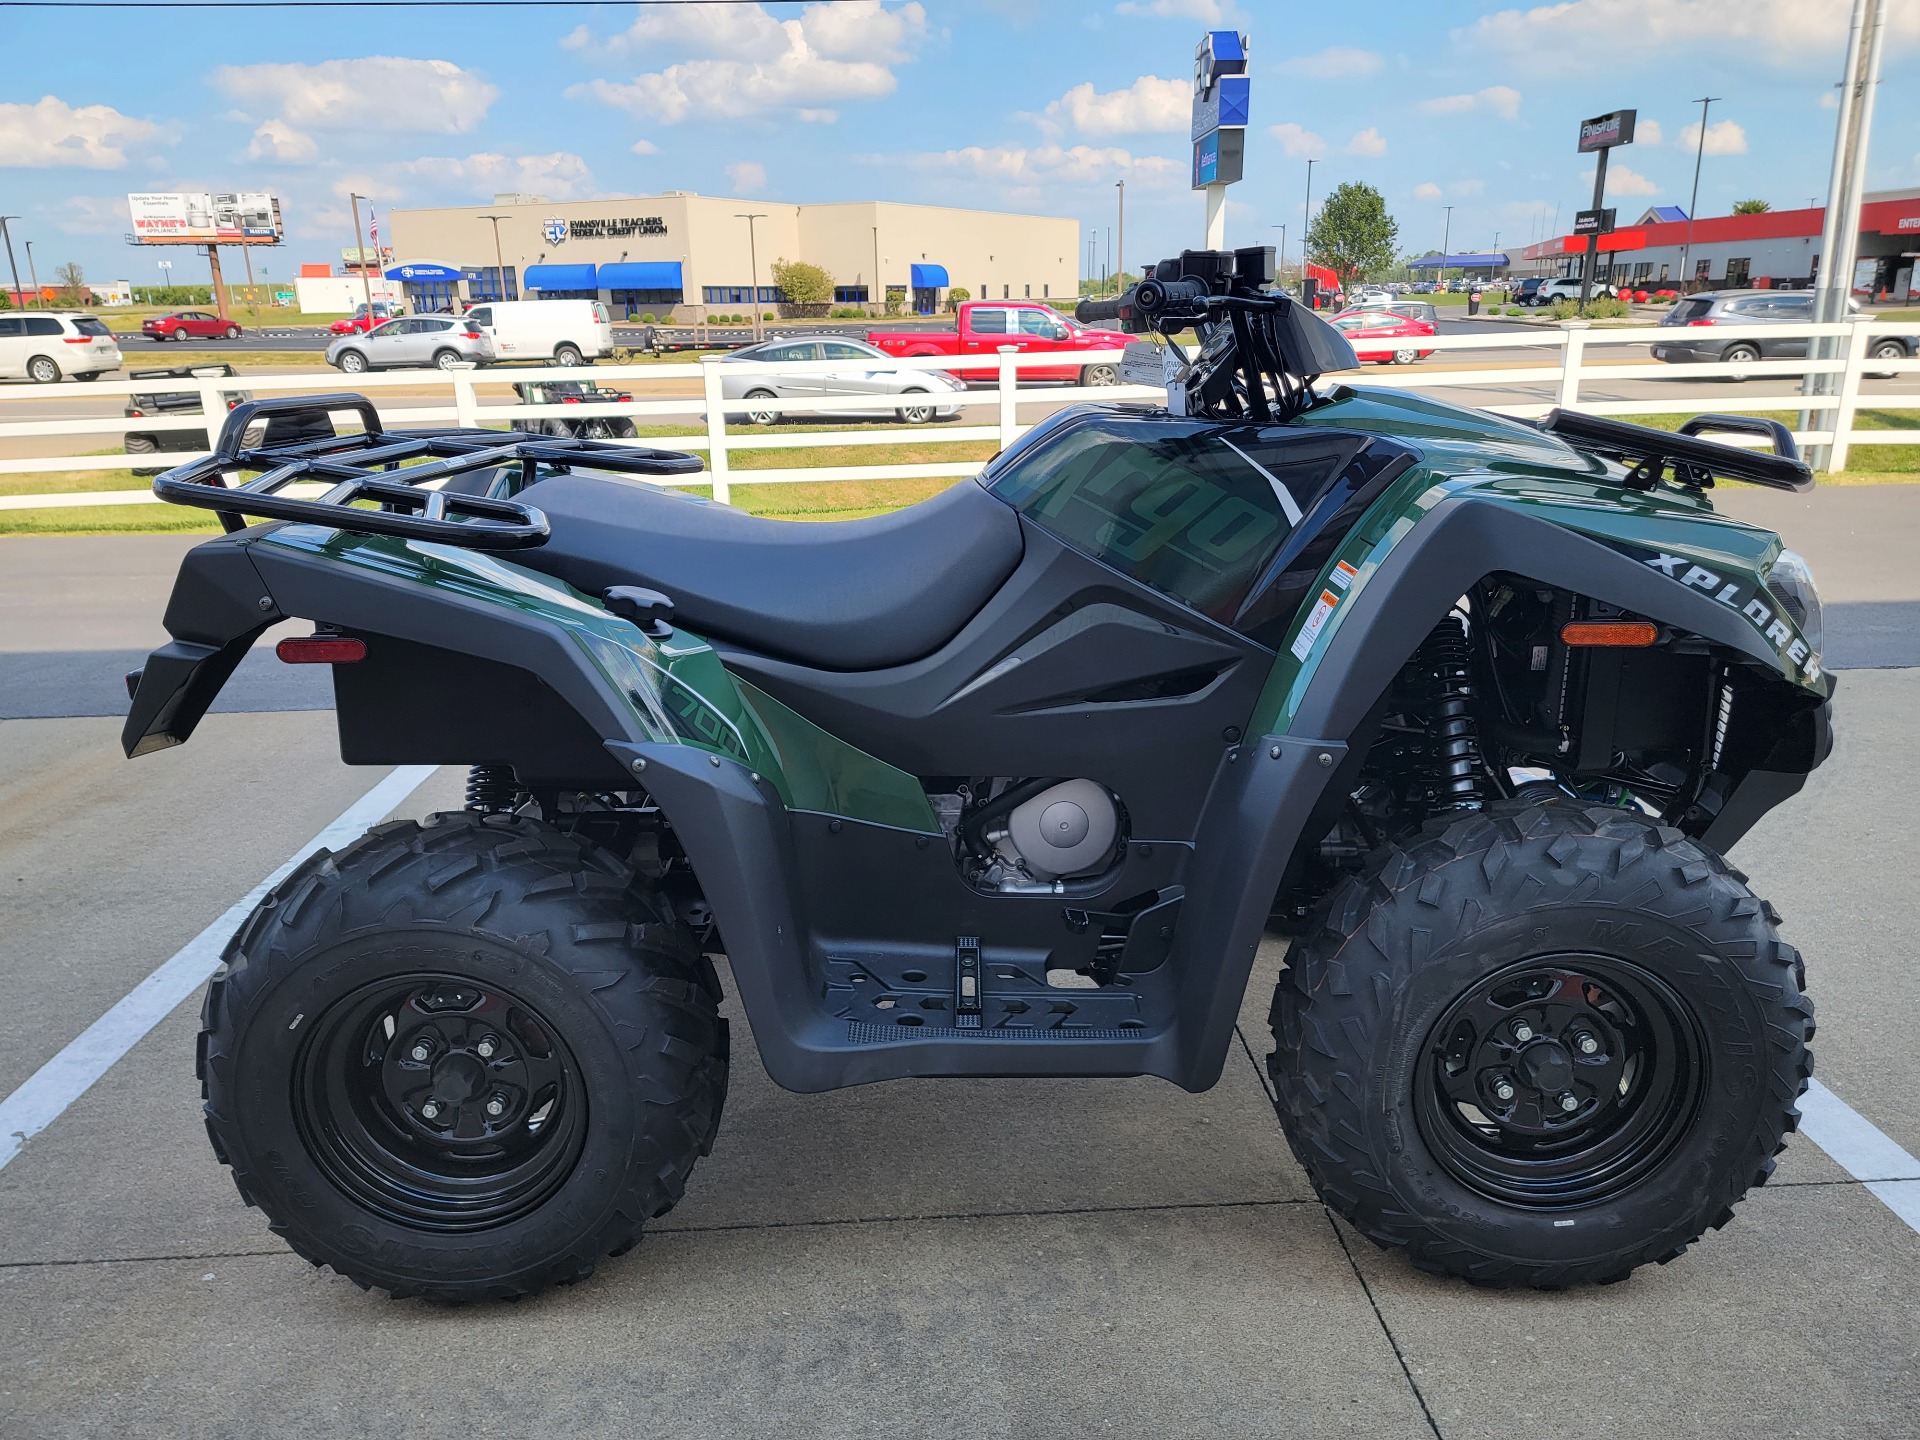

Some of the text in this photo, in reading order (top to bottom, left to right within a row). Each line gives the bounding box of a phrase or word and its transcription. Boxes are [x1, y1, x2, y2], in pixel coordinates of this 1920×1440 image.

[1582, 121, 1606, 137] FINISH
[135, 219, 187, 228] WAYNE'S
[569, 216, 663, 229] EVANSVILLE TEACHERS
[570, 225, 667, 237] FEDERAL CREDIT UNION
[1644, 552, 1821, 684] XPLORER
[672, 685, 741, 758] 700
